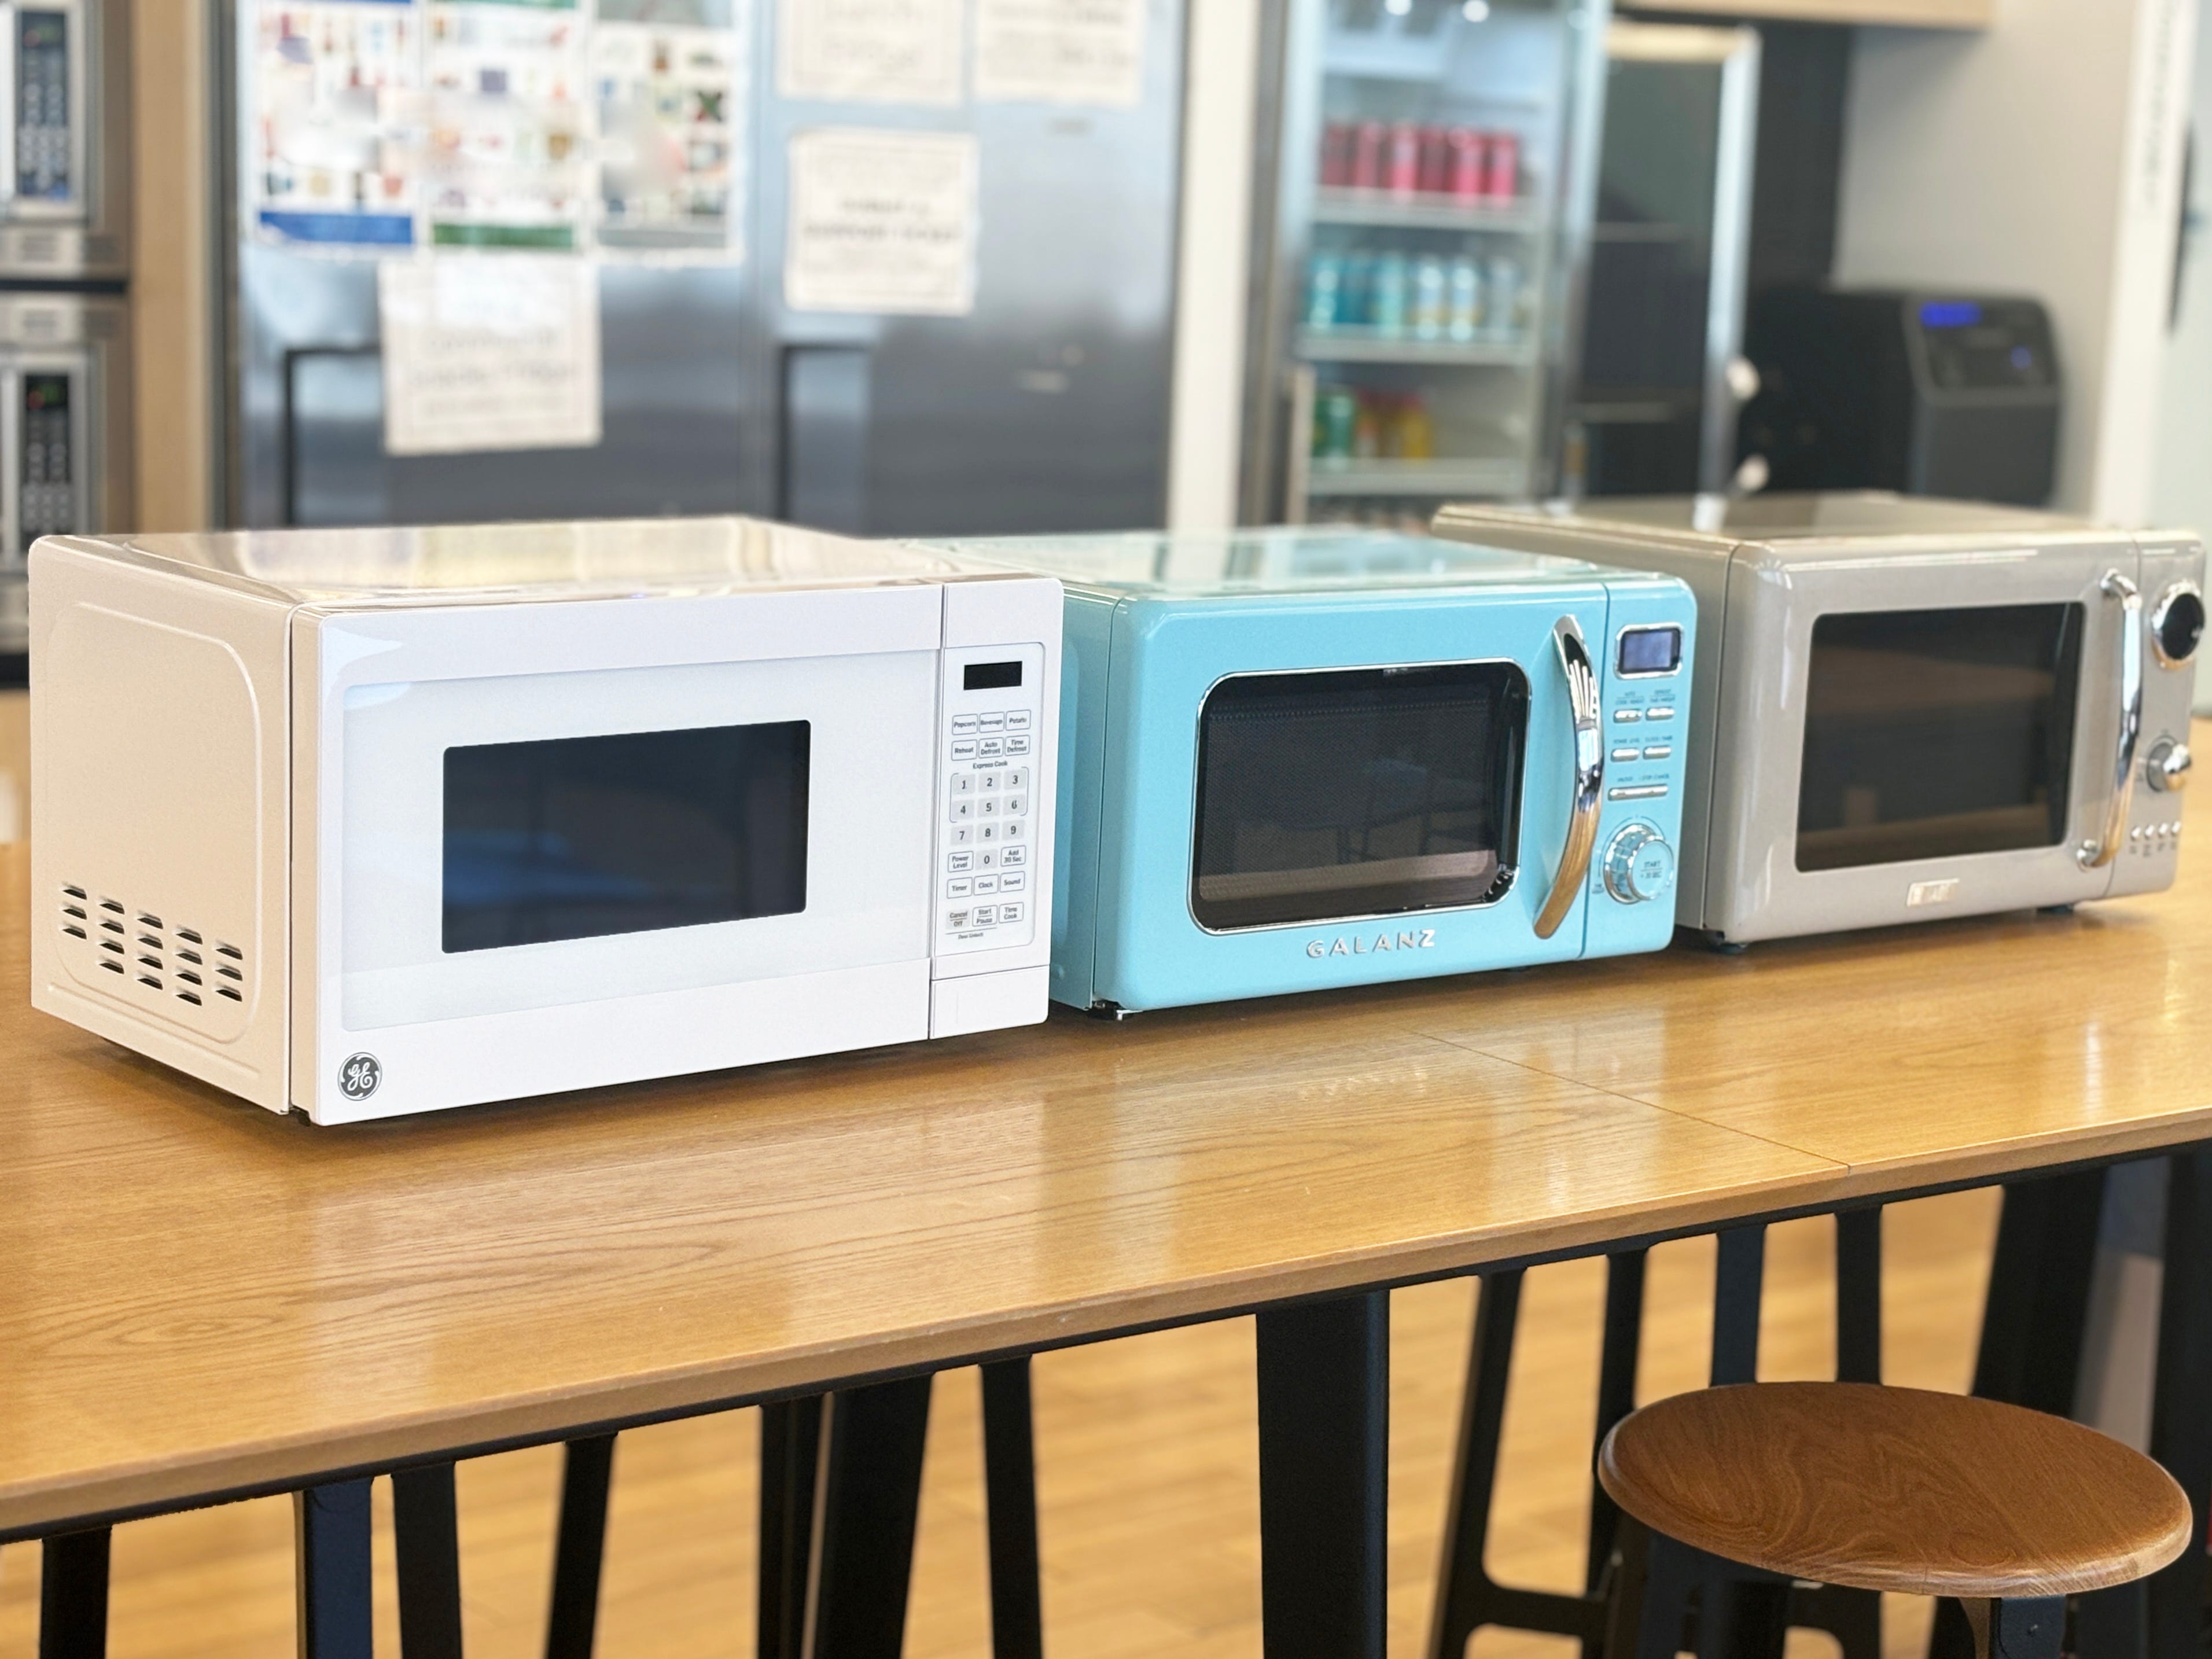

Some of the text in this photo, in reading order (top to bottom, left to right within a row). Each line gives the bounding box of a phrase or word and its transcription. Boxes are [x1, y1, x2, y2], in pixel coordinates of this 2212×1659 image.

[987, 778, 993, 787] 2
[1013, 775, 1018, 784] 3
[962, 780, 966, 789] 1
[986, 803, 992, 812] 5
[1011, 800, 1017, 809] 6
[960, 805, 966, 814] 4
[985, 828, 991, 837] 8
[1011, 826, 1017, 834] 9
[959, 831, 965, 840] 7
[984, 855, 990, 864] 0
[1306, 929, 1436, 958] GALANZ
